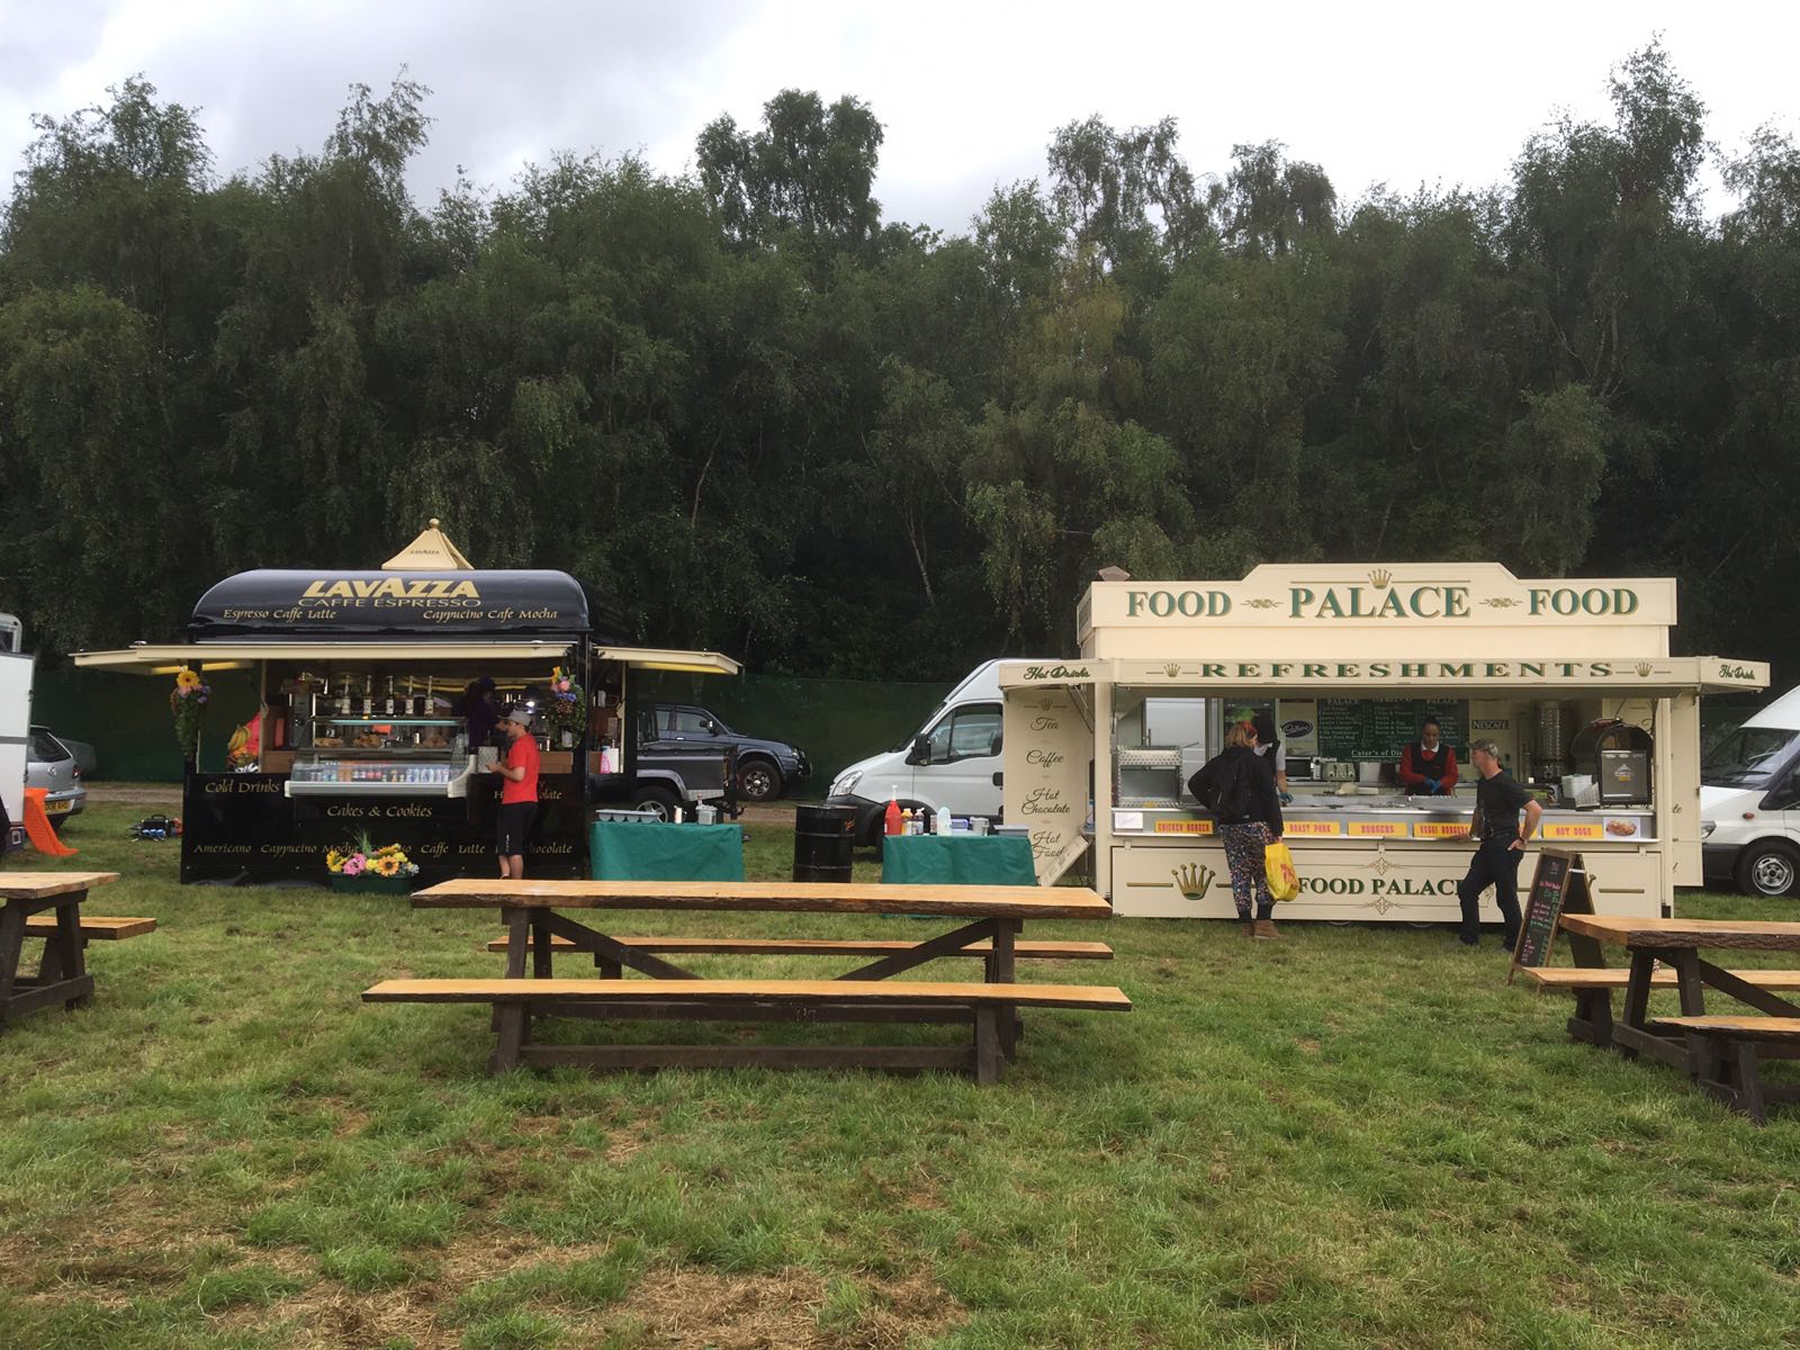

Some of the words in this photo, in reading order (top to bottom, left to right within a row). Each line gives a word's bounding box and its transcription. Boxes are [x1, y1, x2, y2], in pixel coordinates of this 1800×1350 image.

[302, 577, 480, 598] LAVAZZA
[298, 599, 366, 607] CAFFE
[374, 599, 482, 608] ESPRESSO
[1126, 590, 1233, 618] FOOD
[1289, 586, 1472, 619] PALACE
[1527, 588, 1640, 616] FOOD
[223, 609, 270, 622] Espresso
[273, 607, 302, 622] Caffe
[308, 609, 337, 619] Latte
[423, 609, 484, 623] Cappucino
[487, 608, 514, 623] Cafe
[518, 607, 558, 619] Mocha
[1023, 666, 1050, 680] Hot
[1050, 665, 1091, 678] Drinks
[1199, 662, 1614, 679] REFRESHMENTS
[1030, 717, 1059, 731] Tea
[1026, 749, 1064, 768] Coffee
[205, 779, 234, 793] Cold
[238, 779, 280, 793] Drinks
[1026, 787, 1060, 802] Hot
[327, 803, 364, 817] Cakes
[368, 806, 381, 817] &
[386, 803, 433, 817] Cookies
[1021, 801, 1071, 816] Chocolate
[1290, 824, 1311, 833] ROAST
[1314, 824, 1332, 833] PORK
[1361, 825, 1395, 834] BURGERS
[1556, 827, 1570, 836] HOT
[1573, 827, 1592, 836] DOGS
[1031, 831, 1061, 847] Hot
[194, 844, 252, 853] Americano
[260, 843, 317, 857] Cappucino
[421, 842, 449, 858] Caffe
[458, 844, 486, 854] Latte
[1033, 845, 1066, 859] Food
[1298, 877, 1365, 895] FOOD
